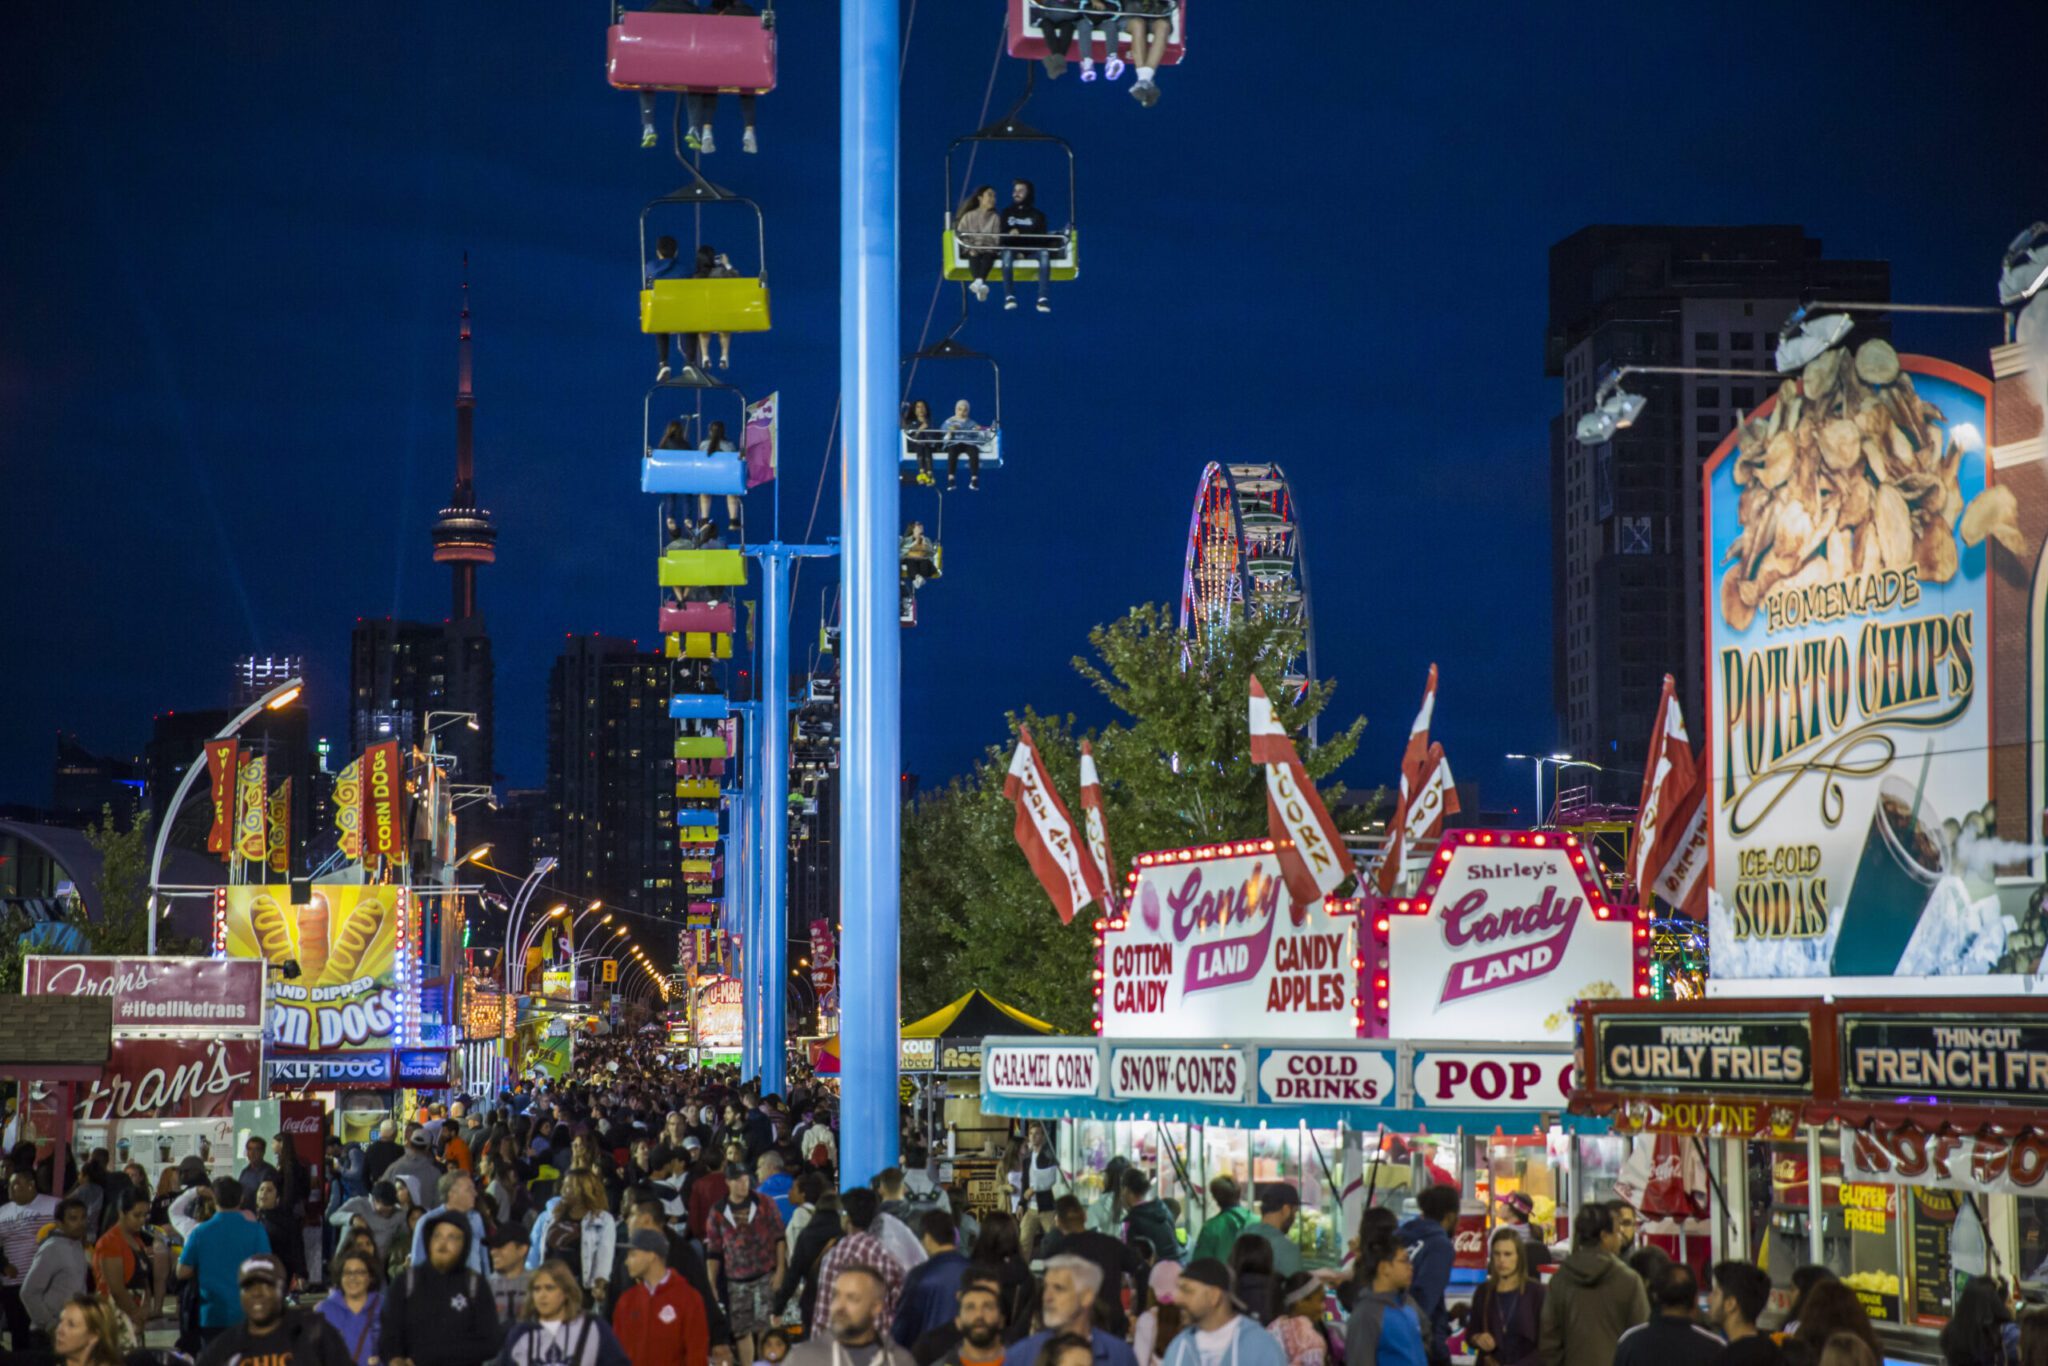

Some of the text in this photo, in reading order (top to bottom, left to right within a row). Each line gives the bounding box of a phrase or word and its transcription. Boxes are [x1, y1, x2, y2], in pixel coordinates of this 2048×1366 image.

[1766, 564, 1921, 634] HOMEMADE
[1720, 611, 1974, 811] POTATO CHIPS
[371, 749, 391, 850] CORN DOGS
[1467, 861, 1558, 880] Shirley's
[1738, 845, 1821, 878] ICE-COLD
[1167, 862, 1284, 942] Candy
[1440, 885, 1584, 947] Candy
[1733, 879, 1828, 940] SODAS
[1113, 943, 1172, 978] COTTON
[1197, 943, 1249, 981] LAND
[1275, 934, 1343, 972] CANDY
[1460, 946, 1552, 990] LAND
[47, 963, 158, 995] Fran's
[311, 976, 374, 1002] DIPPED
[1113, 980, 1168, 1013] CANDY
[1266, 974, 1345, 1013] APPLES
[319, 989, 396, 1048] DOGS
[329, 1059, 384, 1077] DOG
[993, 1054, 1093, 1089] CARAMEL CORN
[1287, 1055, 1358, 1076] COLD
[1435, 1061, 1541, 1100] POP
[1611, 1045, 1804, 1081] CURLY FRIES
[1855, 1047, 1998, 1089] FRENCH
[1275, 1078, 1378, 1100] DRINKS
[1661, 1103, 1757, 1132] POUTINE
